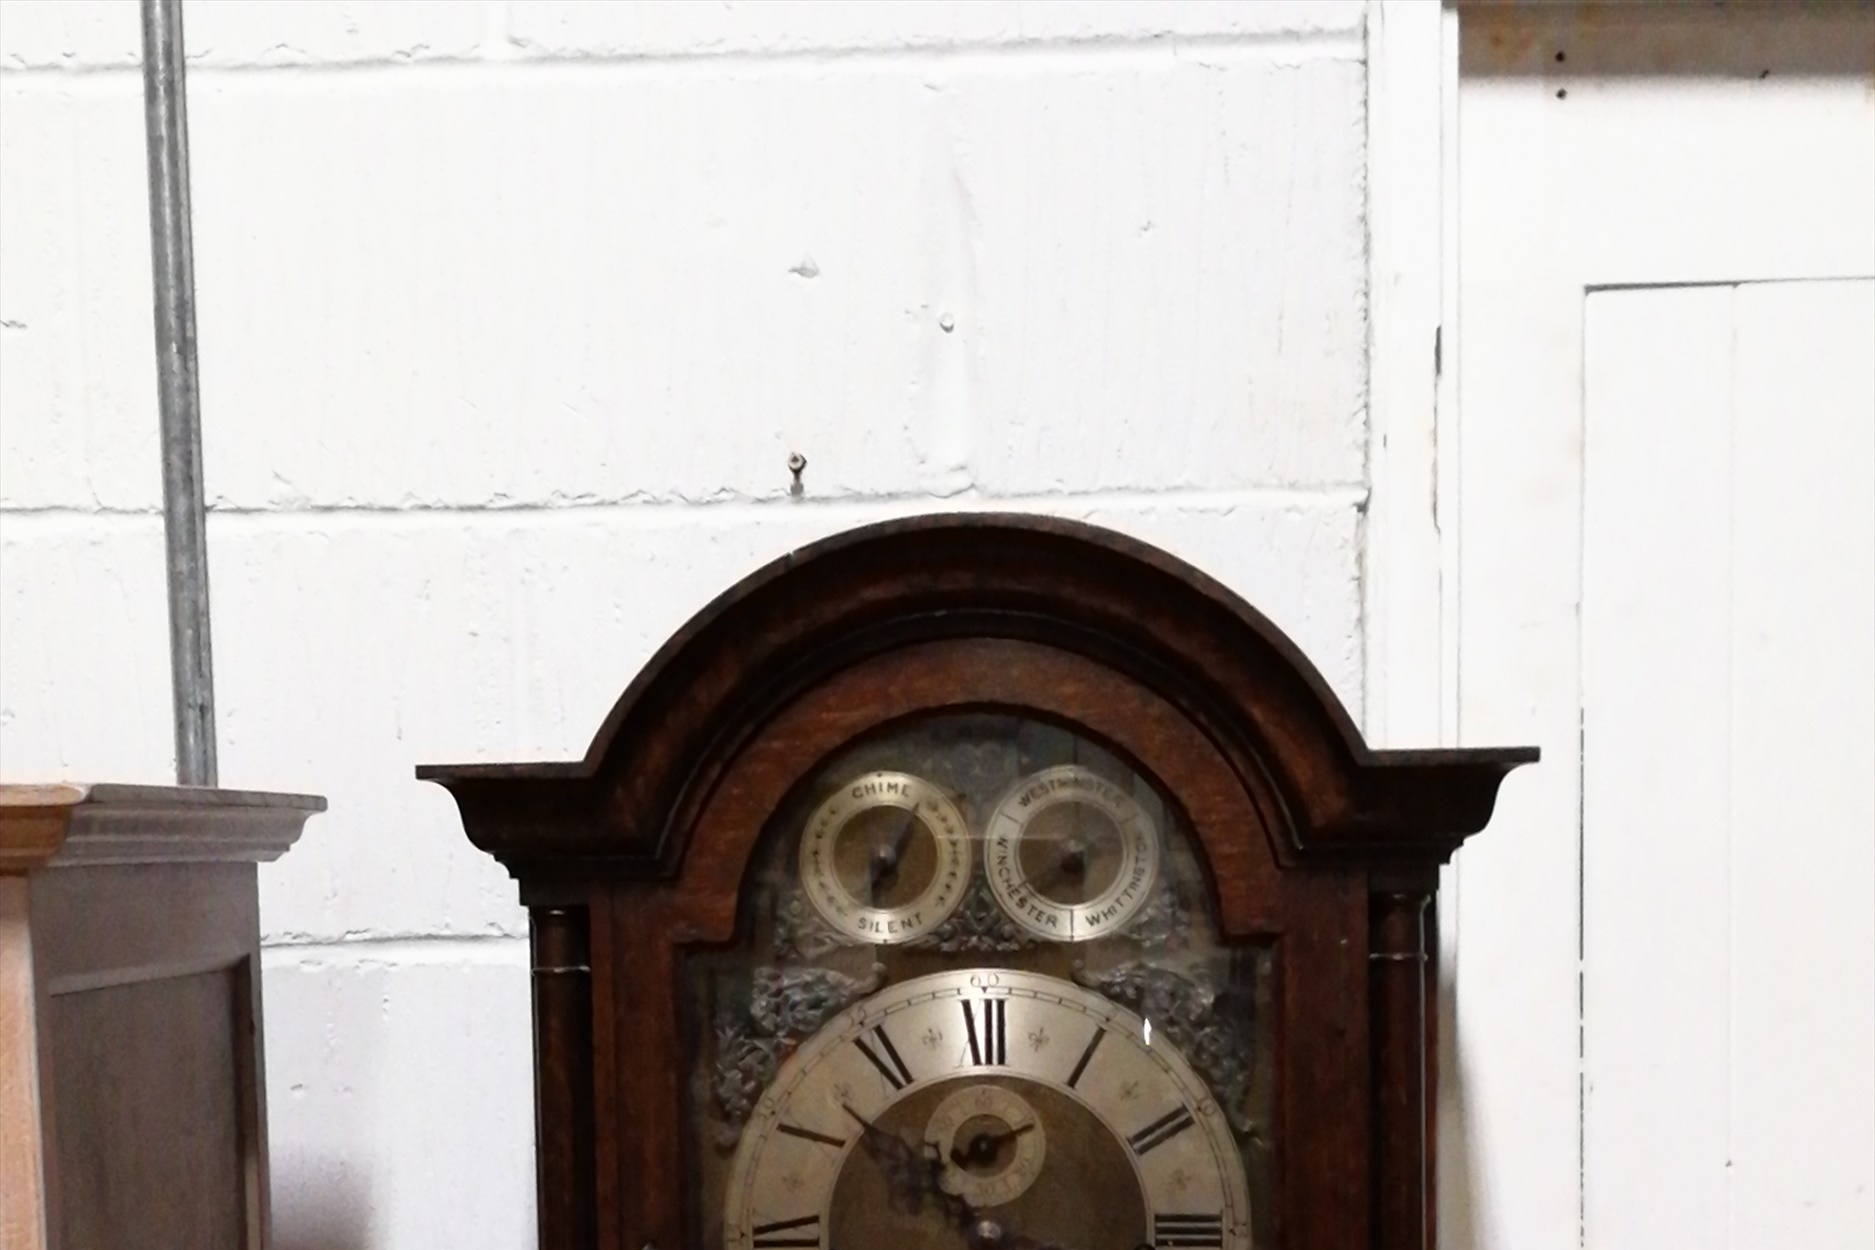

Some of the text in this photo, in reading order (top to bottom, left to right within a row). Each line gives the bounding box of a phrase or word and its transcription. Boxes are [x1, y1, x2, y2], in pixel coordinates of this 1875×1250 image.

[851, 782, 910, 799] CHIME
[995, 836, 1059, 929] WINCHESTER
[856, 913, 925, 934] SILENT
[953, 999, 1008, 1067] XII
[1064, 1025, 1107, 1090] I
[1125, 1102, 1197, 1156] II
[1153, 1212, 1224, 1249] III
